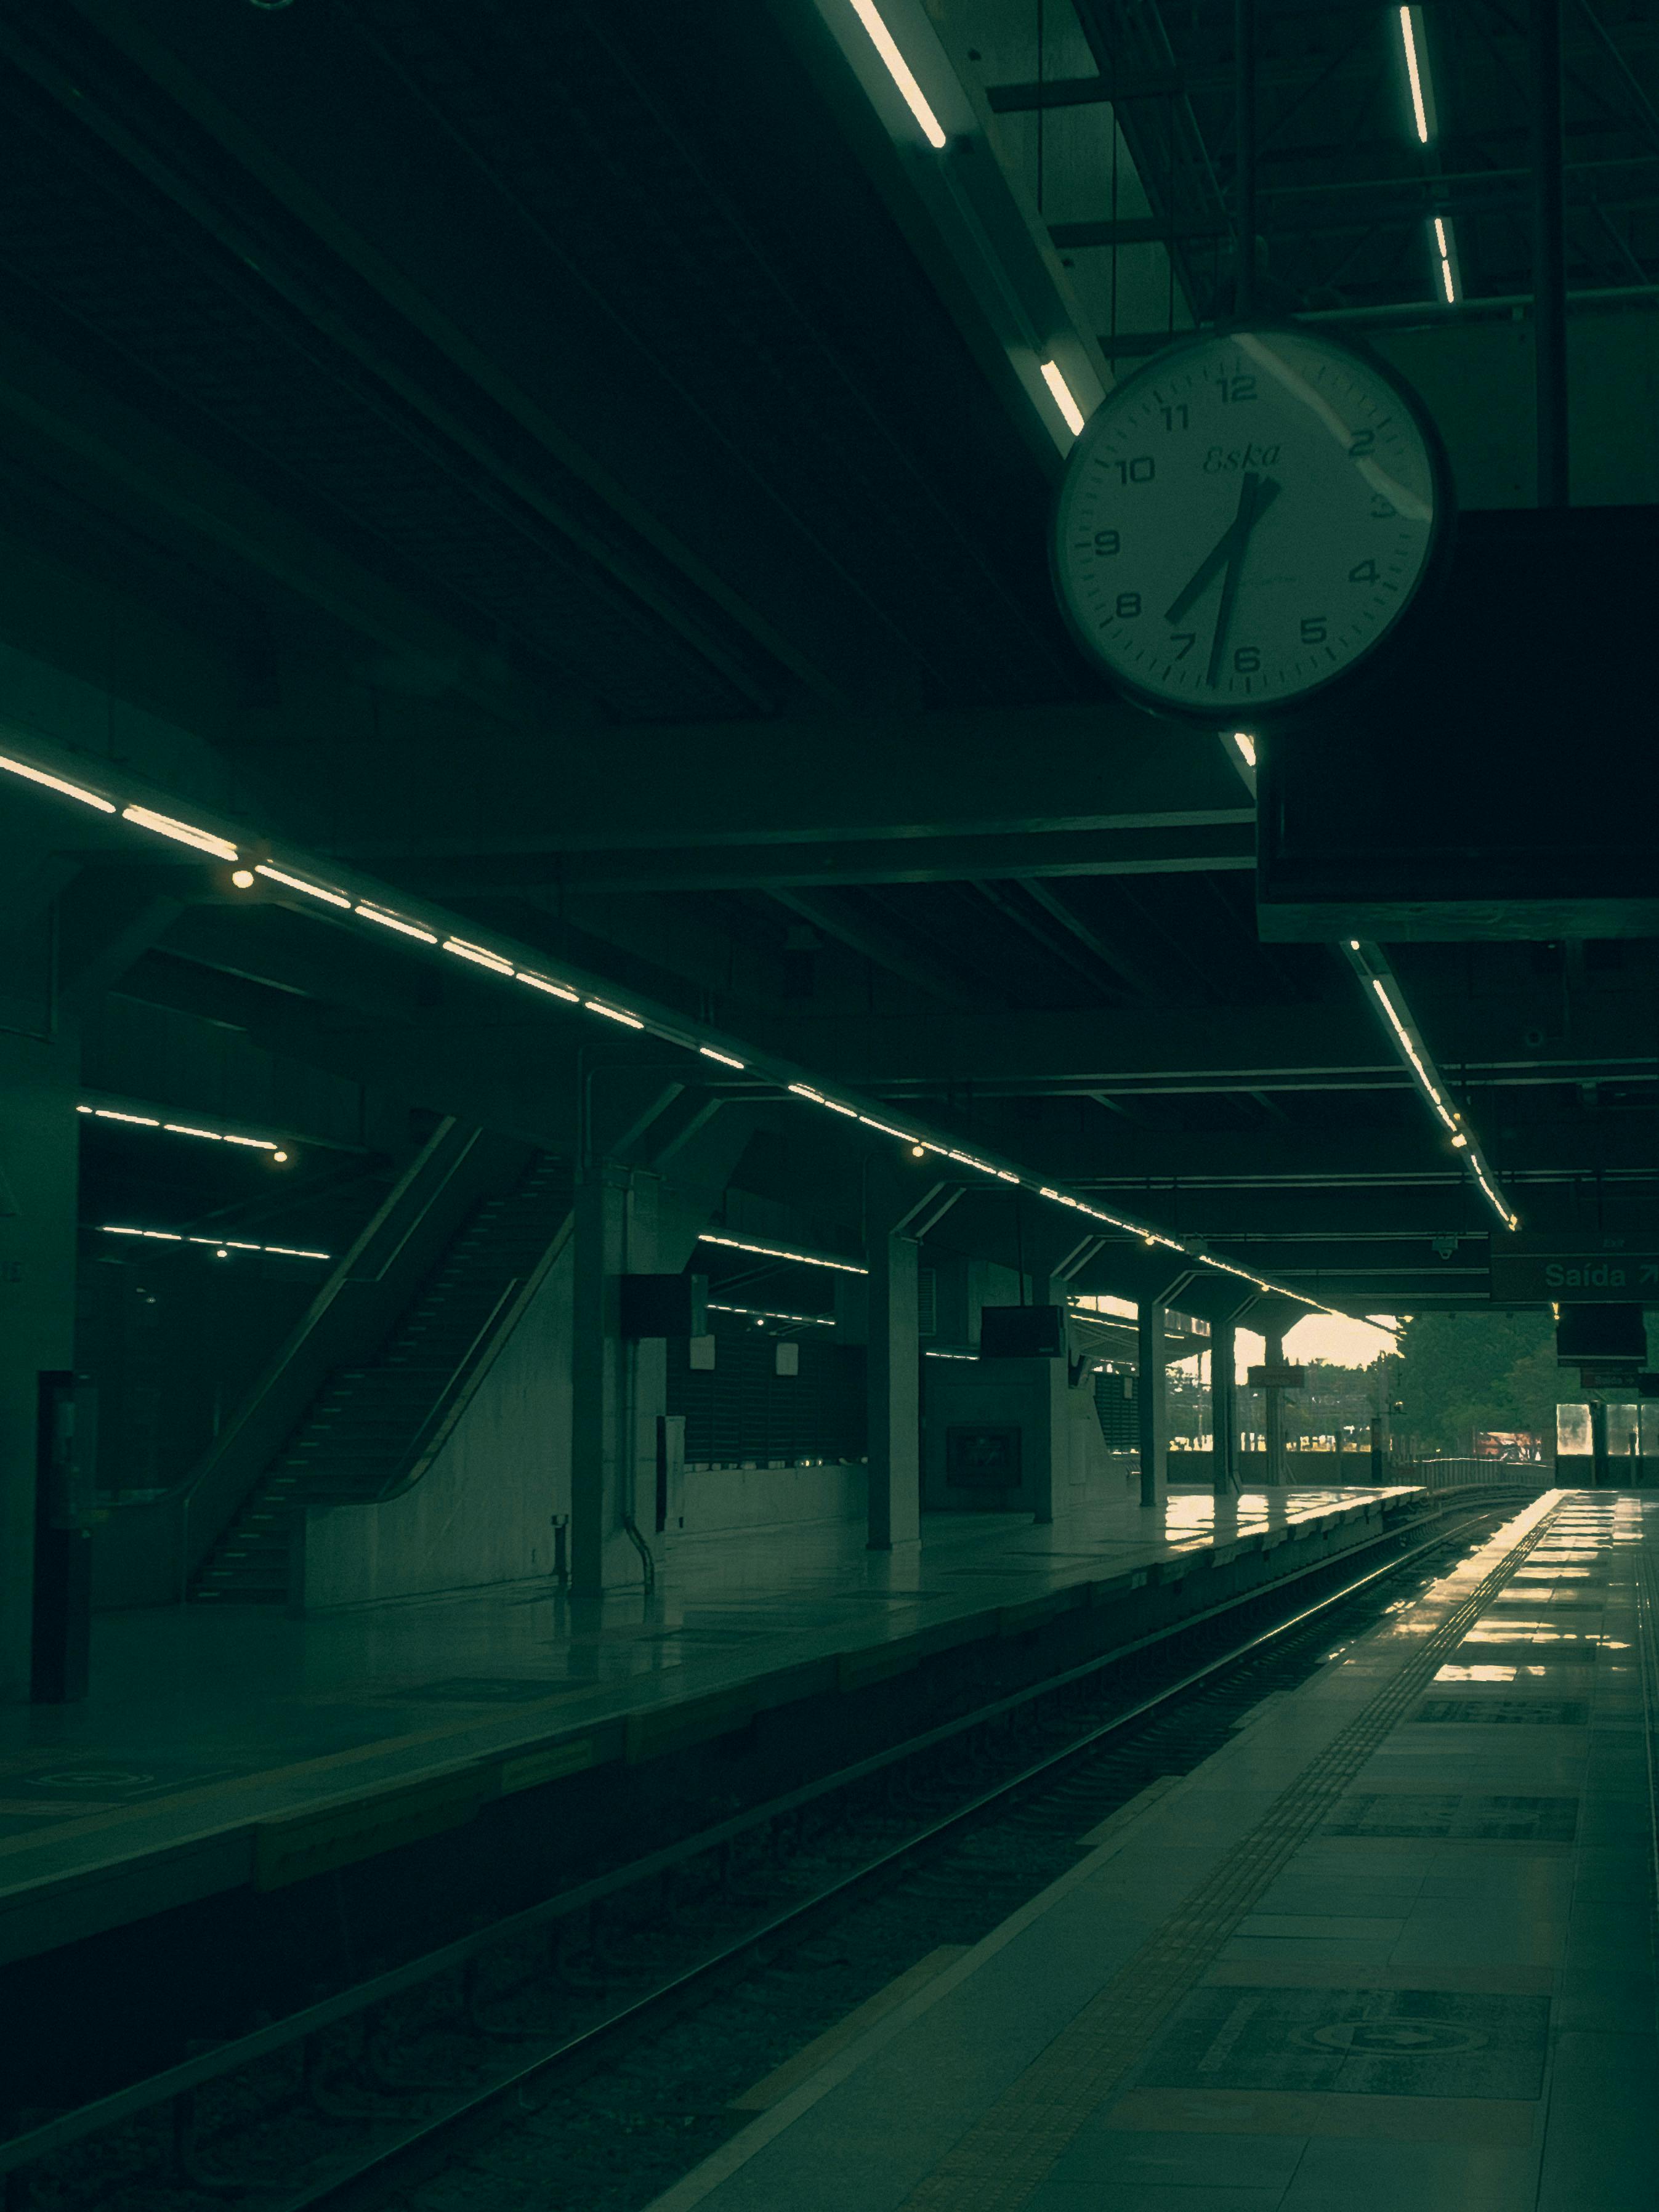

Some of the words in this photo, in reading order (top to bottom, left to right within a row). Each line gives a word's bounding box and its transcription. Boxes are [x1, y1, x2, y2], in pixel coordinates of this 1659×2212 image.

[1216, 376, 1257, 402] 12
[1160, 404, 1189, 431] 11
[1348, 430, 1374, 457] 2
[1115, 457, 1155, 484] 10
[1203, 443, 1282, 474] Eska
[1094, 530, 1120, 555] 9
[1348, 559, 1380, 585] 4
[1116, 592, 1142, 618] 8
[1300, 616, 1327, 644] 5
[1170, 632, 1196, 661] 7
[1233, 647, 1261, 673] 6
[1546, 1262, 1626, 1287] Saída
